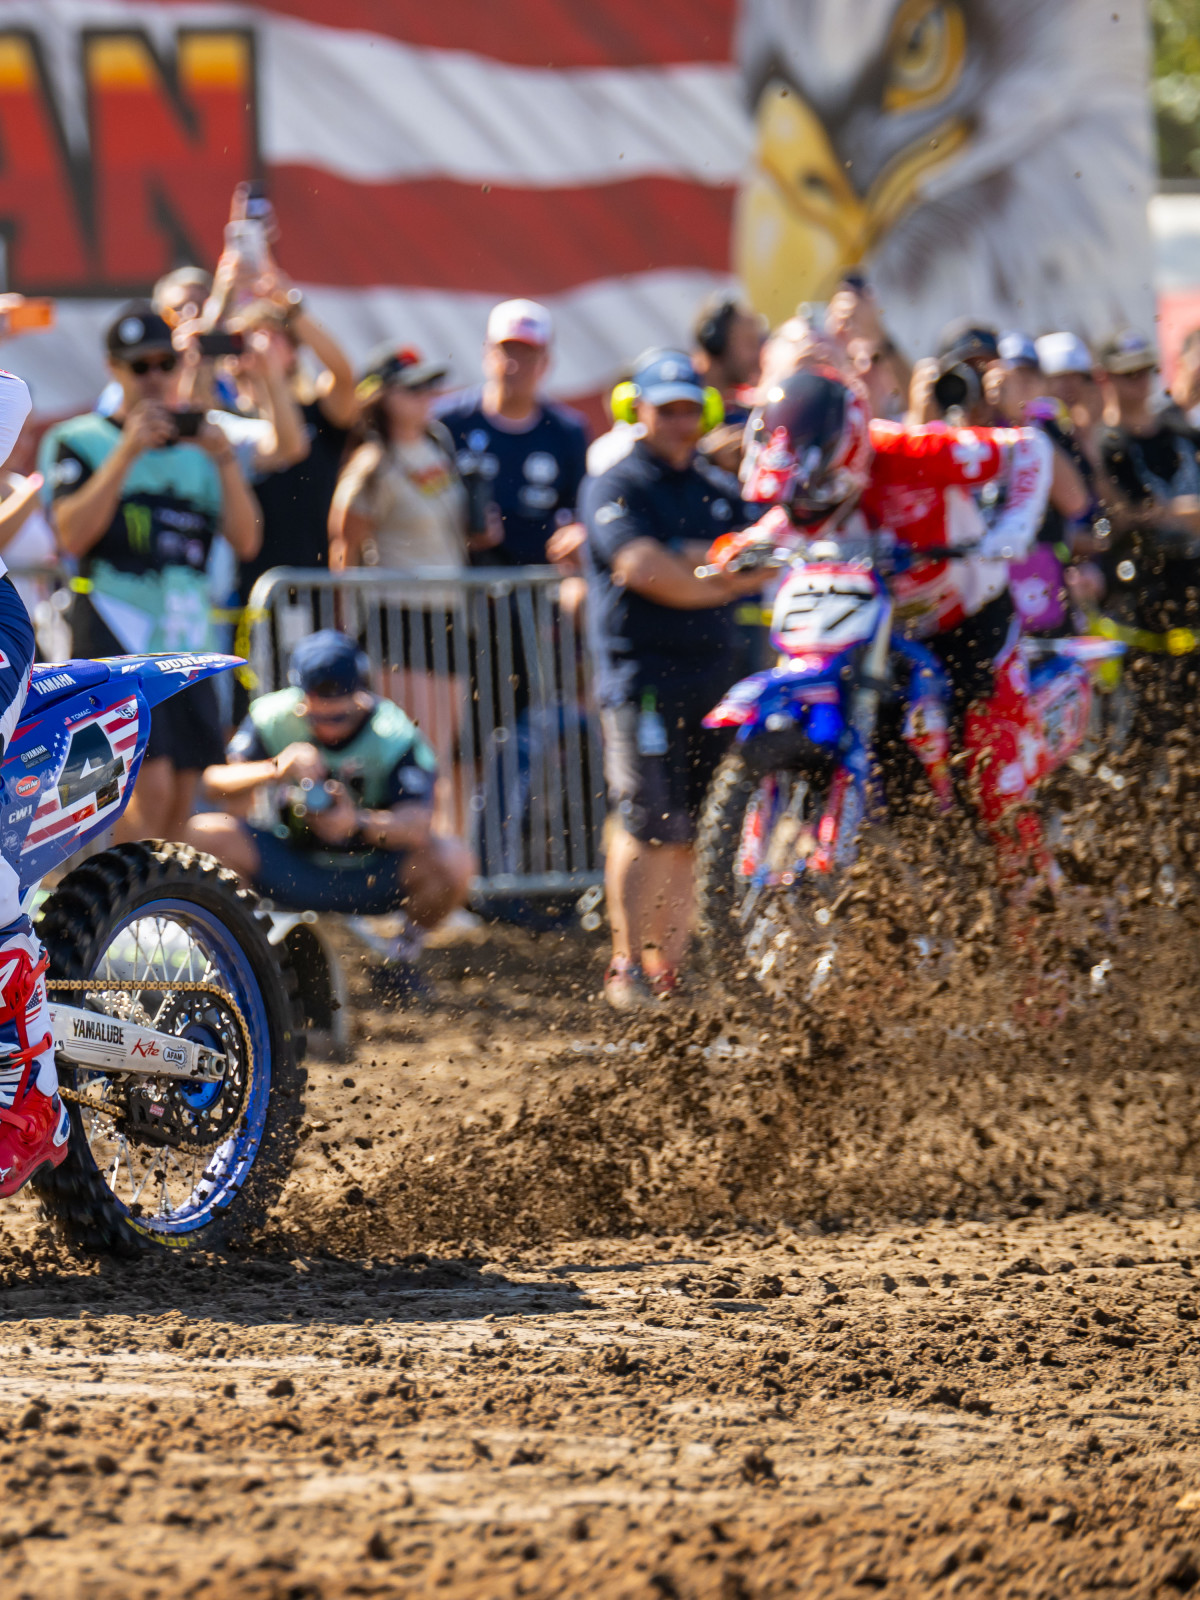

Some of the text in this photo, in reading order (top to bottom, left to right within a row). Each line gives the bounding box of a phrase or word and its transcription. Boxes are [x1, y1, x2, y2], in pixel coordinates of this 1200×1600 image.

[32, 673, 77, 695] YAMAHA
[70, 708, 91, 721] TOMAC
[26, 745, 48, 760] YAMAHA
[58, 722, 126, 812] 4
[18, 779, 40, 793] Twin Air
[73, 1018, 125, 1045] YAMALUBE
[131, 1038, 160, 1057] Kite
[166, 1052, 183, 1061] AFAM
